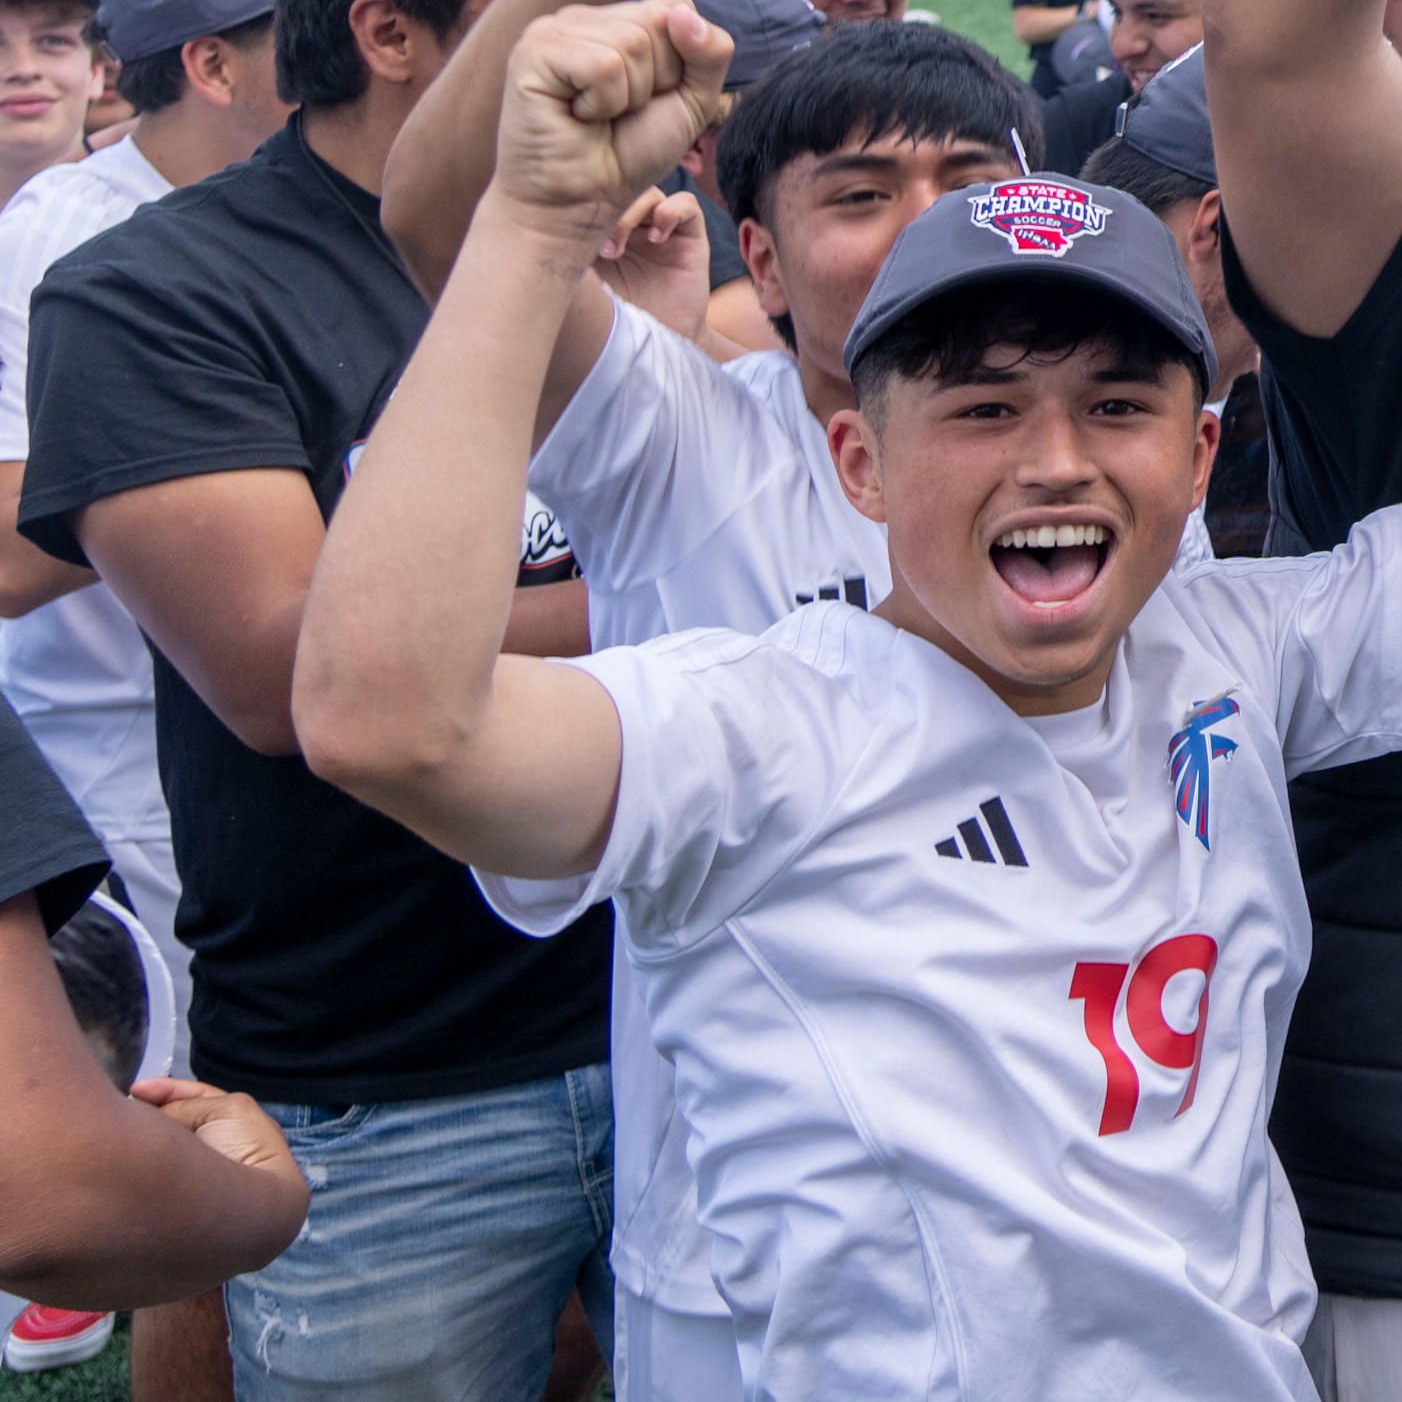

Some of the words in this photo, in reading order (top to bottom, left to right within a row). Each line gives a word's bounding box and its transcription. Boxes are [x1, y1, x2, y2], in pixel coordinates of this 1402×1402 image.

[1017, 185, 1067, 197] STATE
[975, 195, 1104, 229] CHAMPION
[1014, 215, 1062, 227] SOCCER
[1017, 229, 1056, 250] IHSAA
[1068, 933, 1219, 1137] 19
